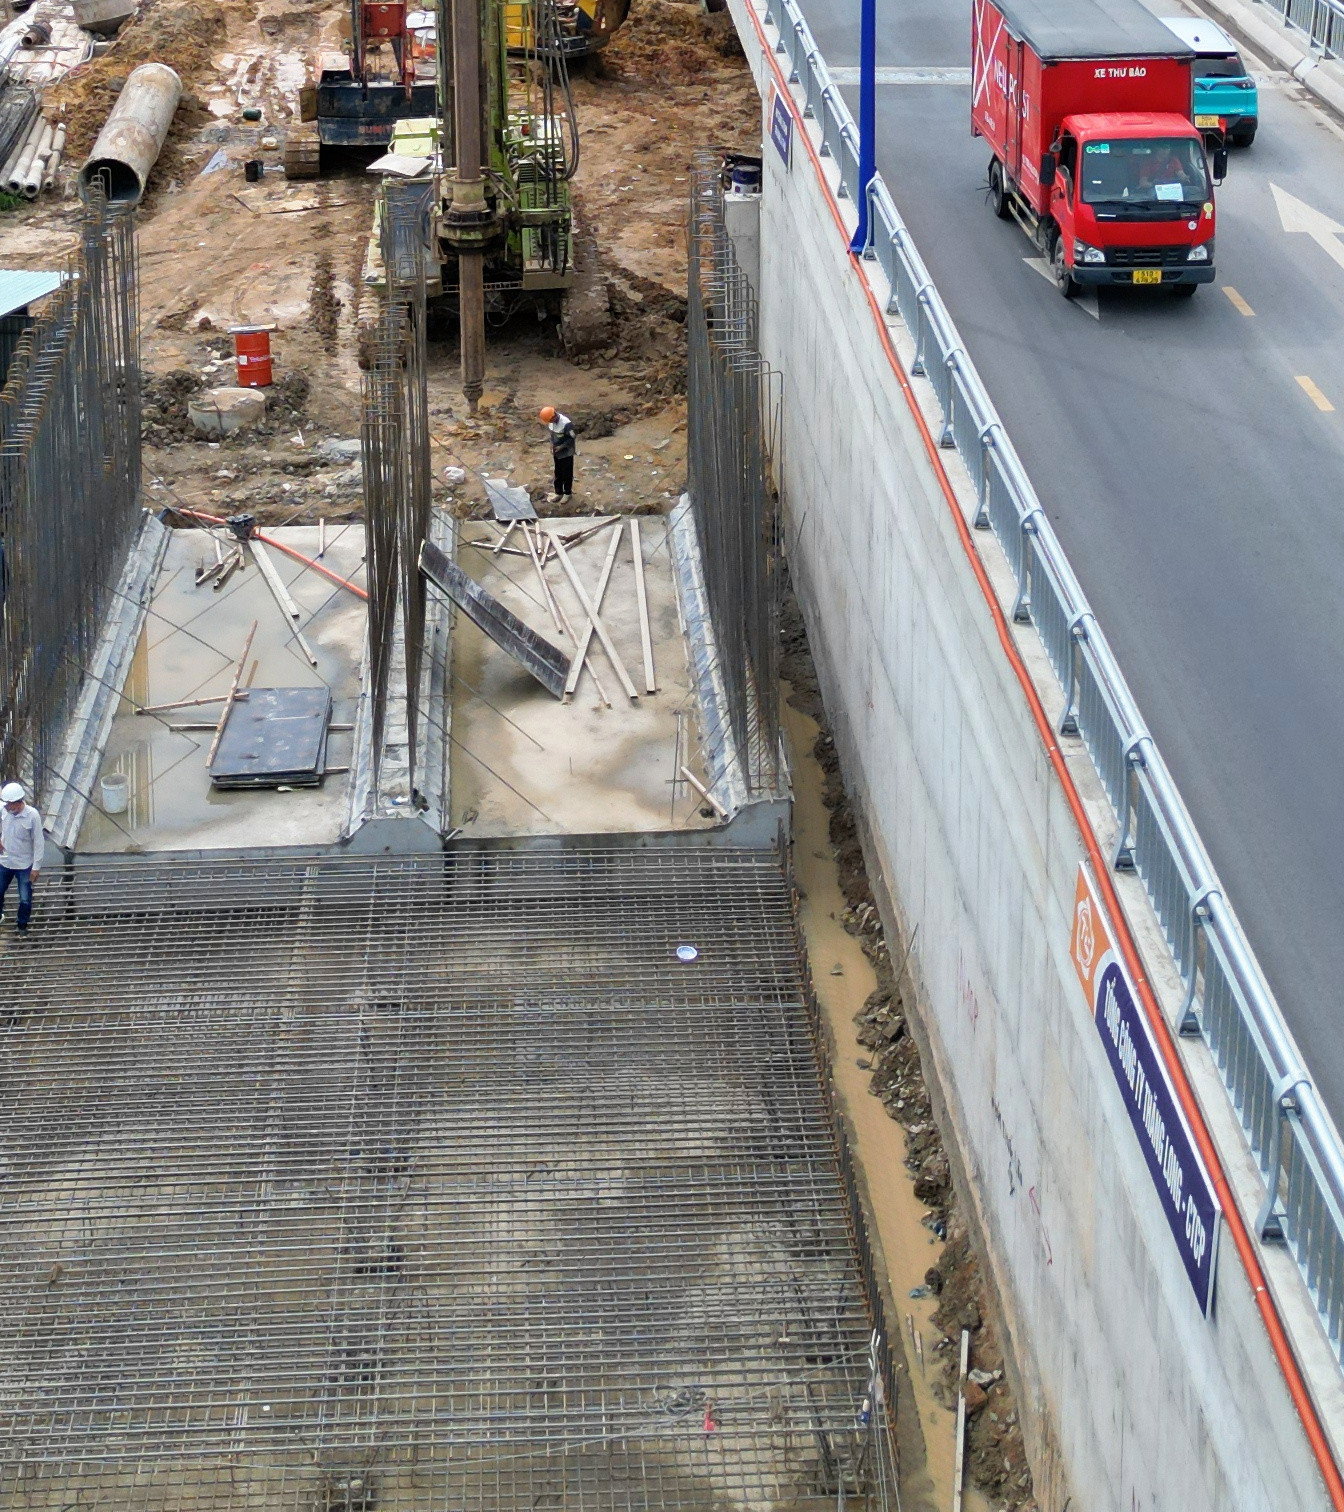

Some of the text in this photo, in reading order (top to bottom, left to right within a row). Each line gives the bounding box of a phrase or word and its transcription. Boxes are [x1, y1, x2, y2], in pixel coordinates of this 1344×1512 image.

[1094, 68, 1106, 78] XE
[1119, 1019, 1137, 1090] CÔNG
[1135, 1059, 1145, 1109] TY
[1163, 1135, 1182, 1213] LONG
[1186, 1194, 1205, 1268] CTCP
